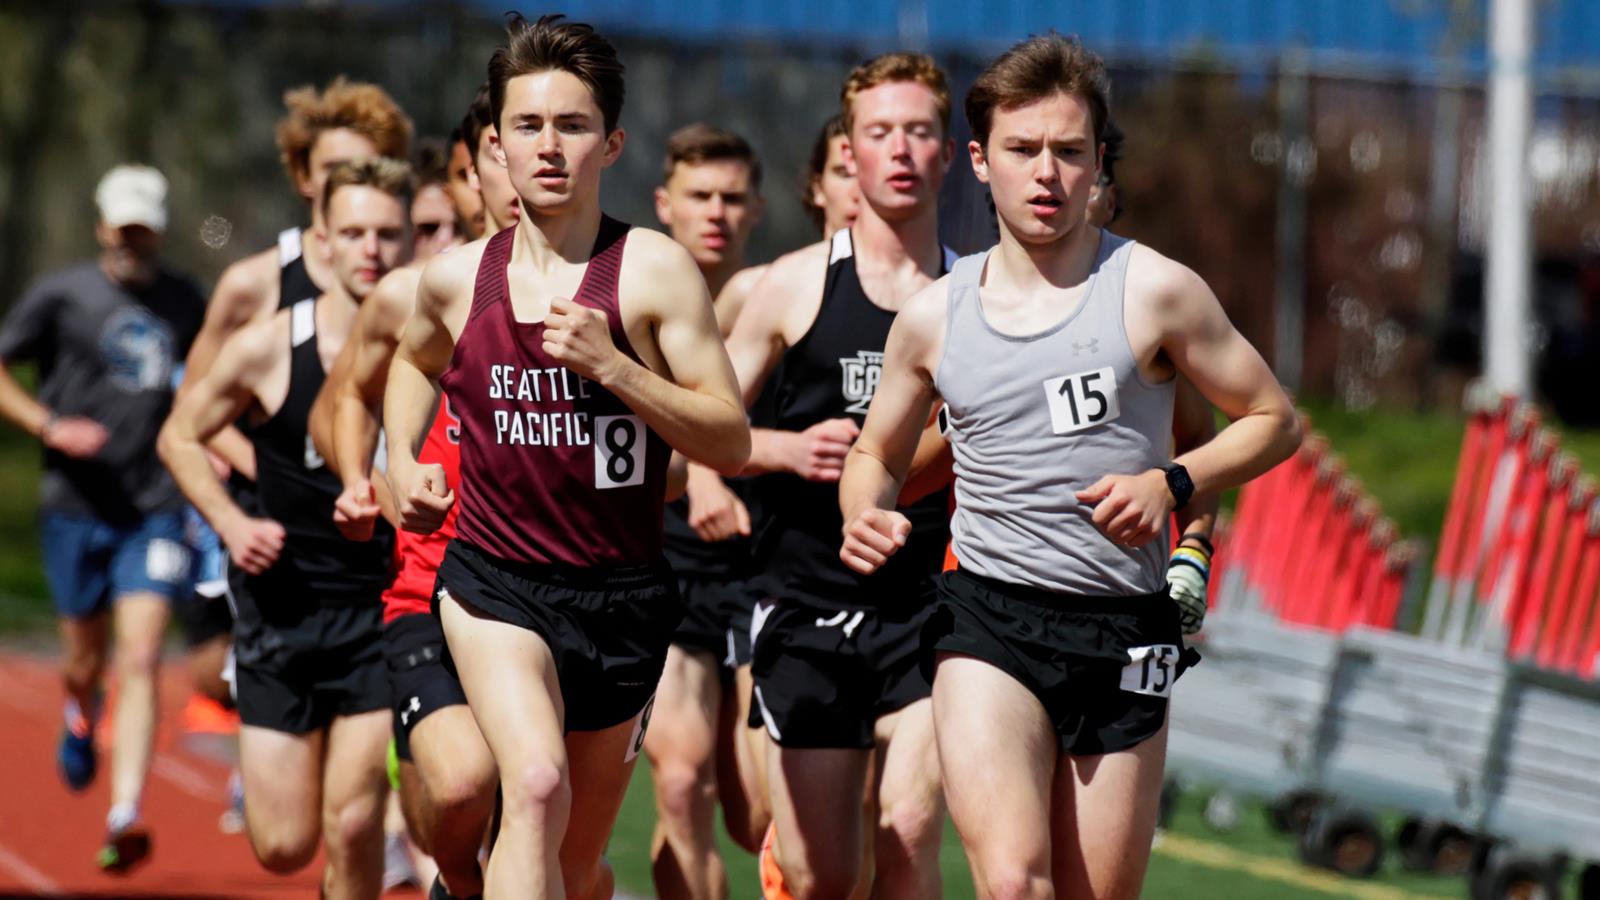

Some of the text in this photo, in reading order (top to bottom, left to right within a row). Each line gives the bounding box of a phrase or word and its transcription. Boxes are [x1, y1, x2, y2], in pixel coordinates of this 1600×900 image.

[489, 364, 591, 402] SEATTLE
[1058, 372, 1108, 426] 15
[493, 410, 591, 447] PACIFIC
[605, 418, 637, 483] 8
[1140, 647, 1173, 692] 15
